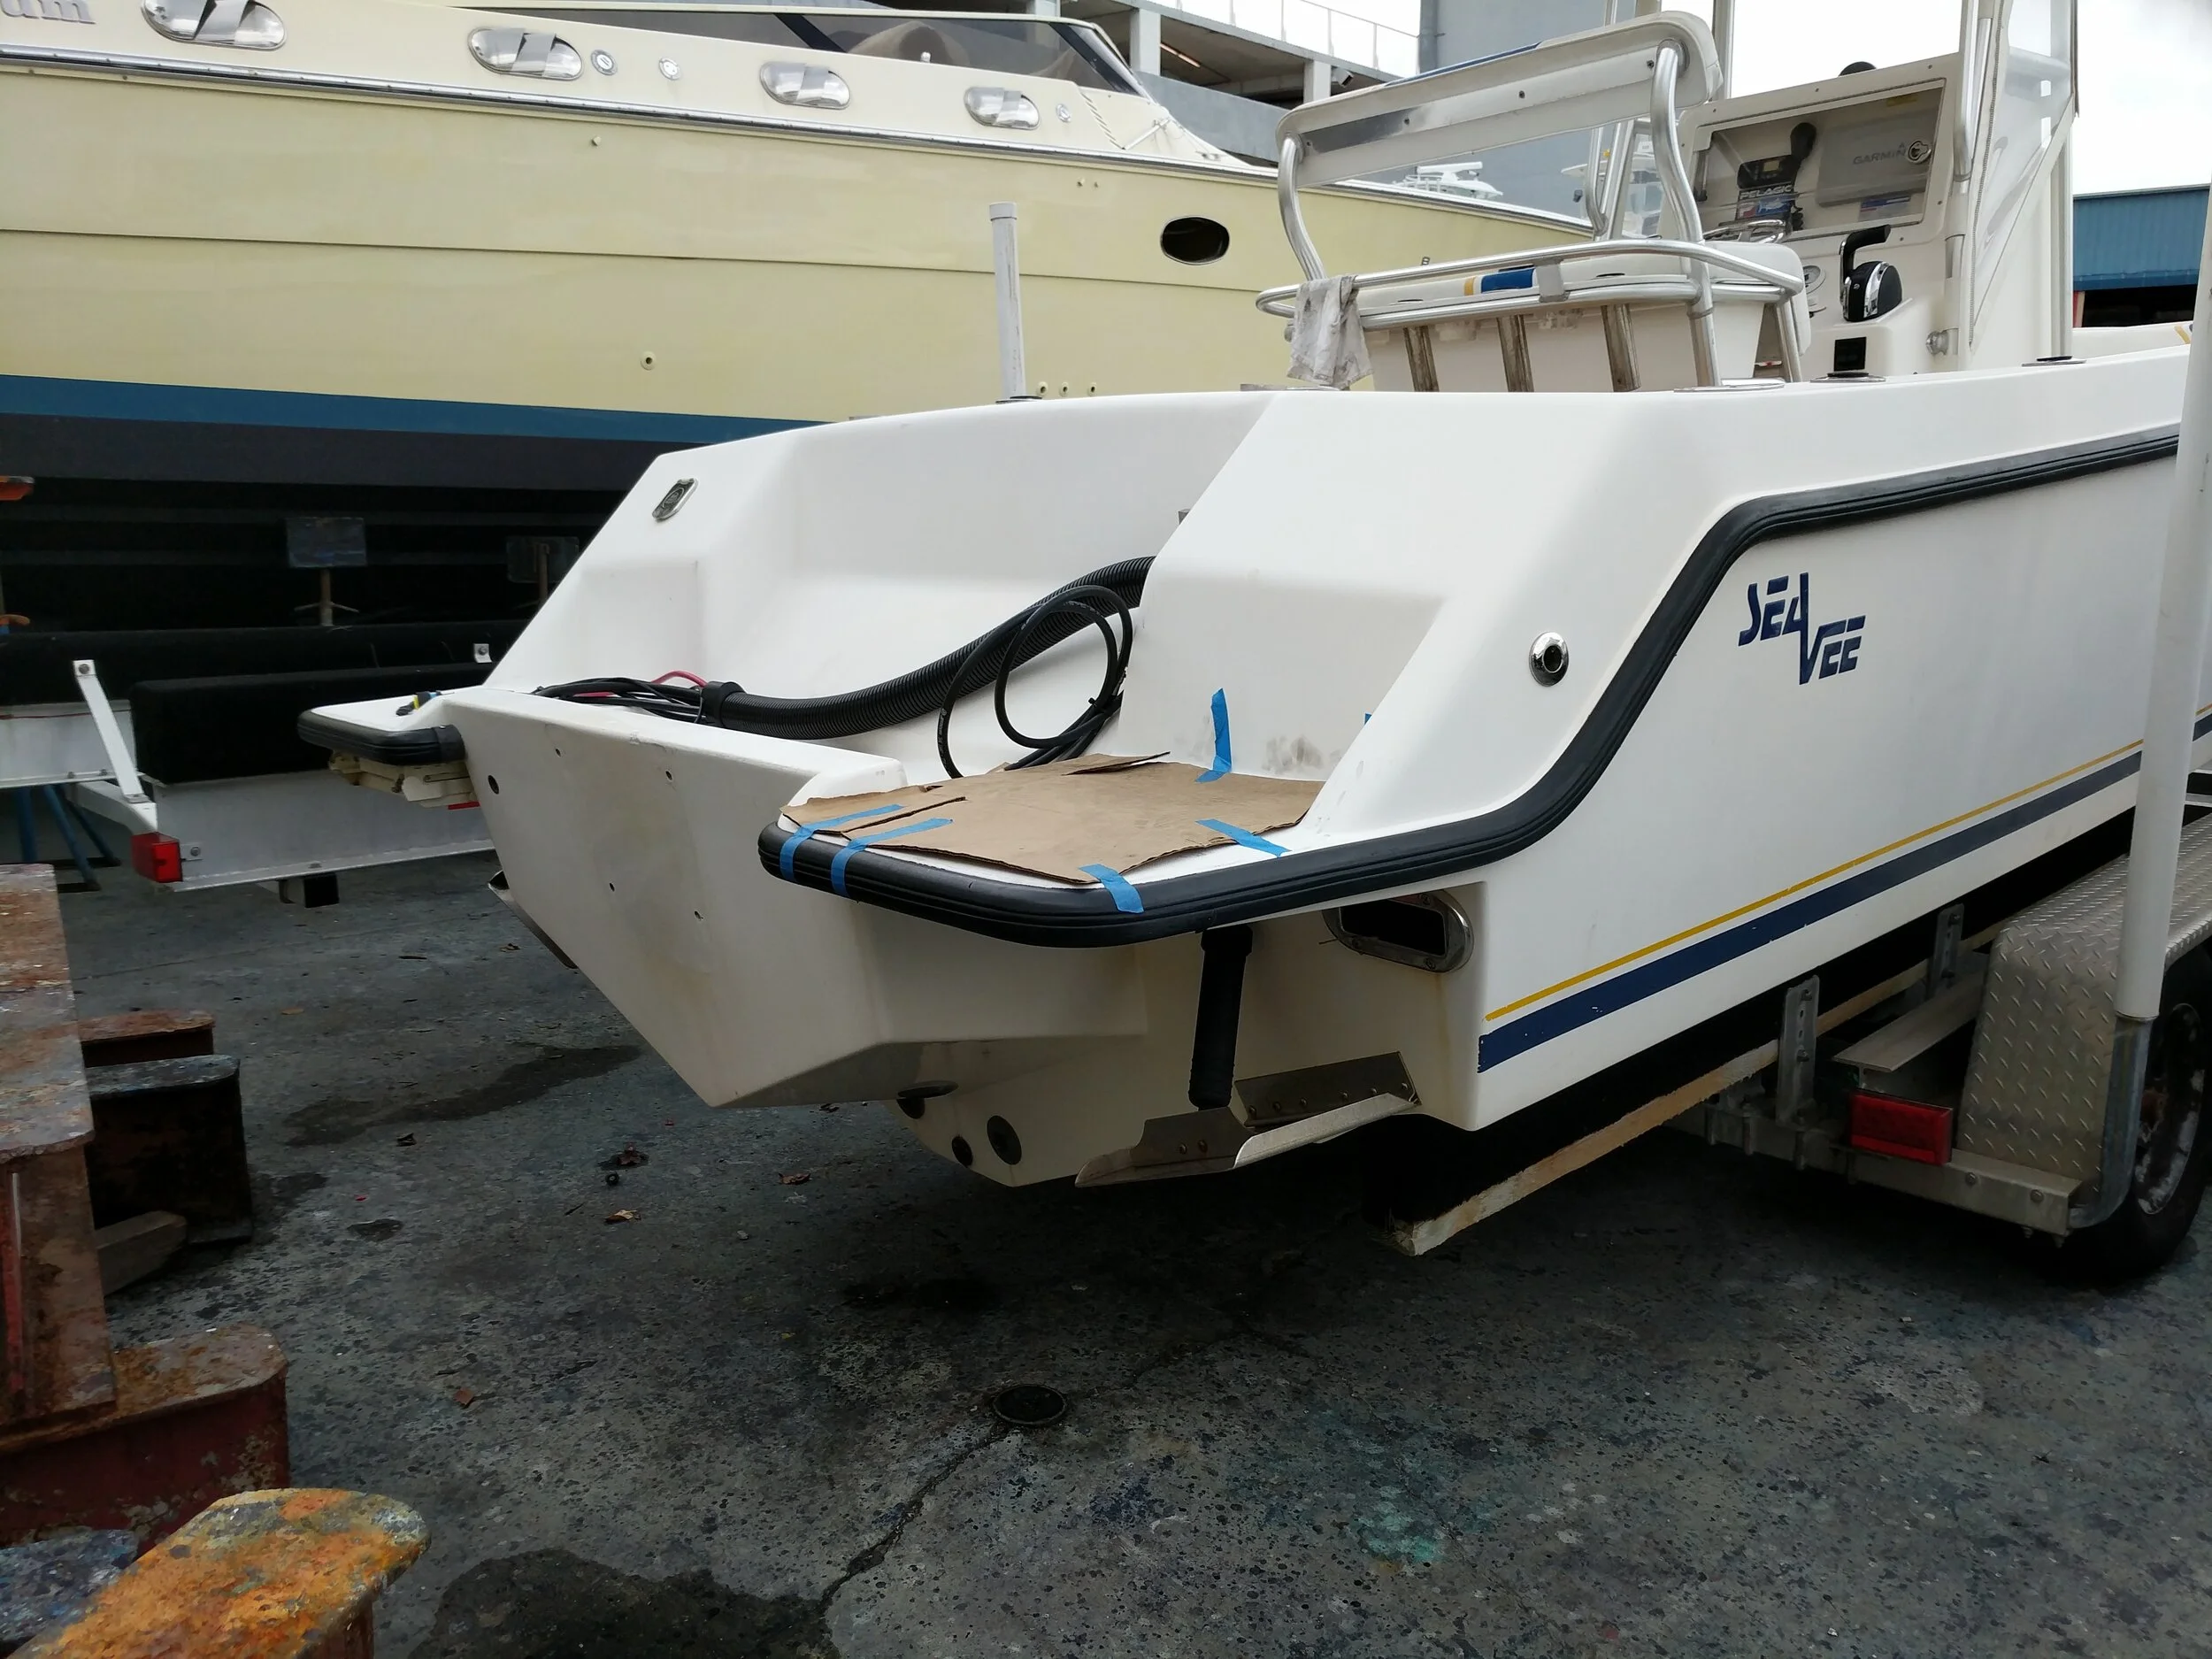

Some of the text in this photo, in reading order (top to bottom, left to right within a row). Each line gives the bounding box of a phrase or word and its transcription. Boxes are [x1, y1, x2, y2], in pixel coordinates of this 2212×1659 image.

[1853, 149, 1907, 165] GARMIN
[1740, 185, 1793, 200] PELAGIC
[1738, 572, 1809, 647] SEA
[1799, 615, 1866, 686] VEE
